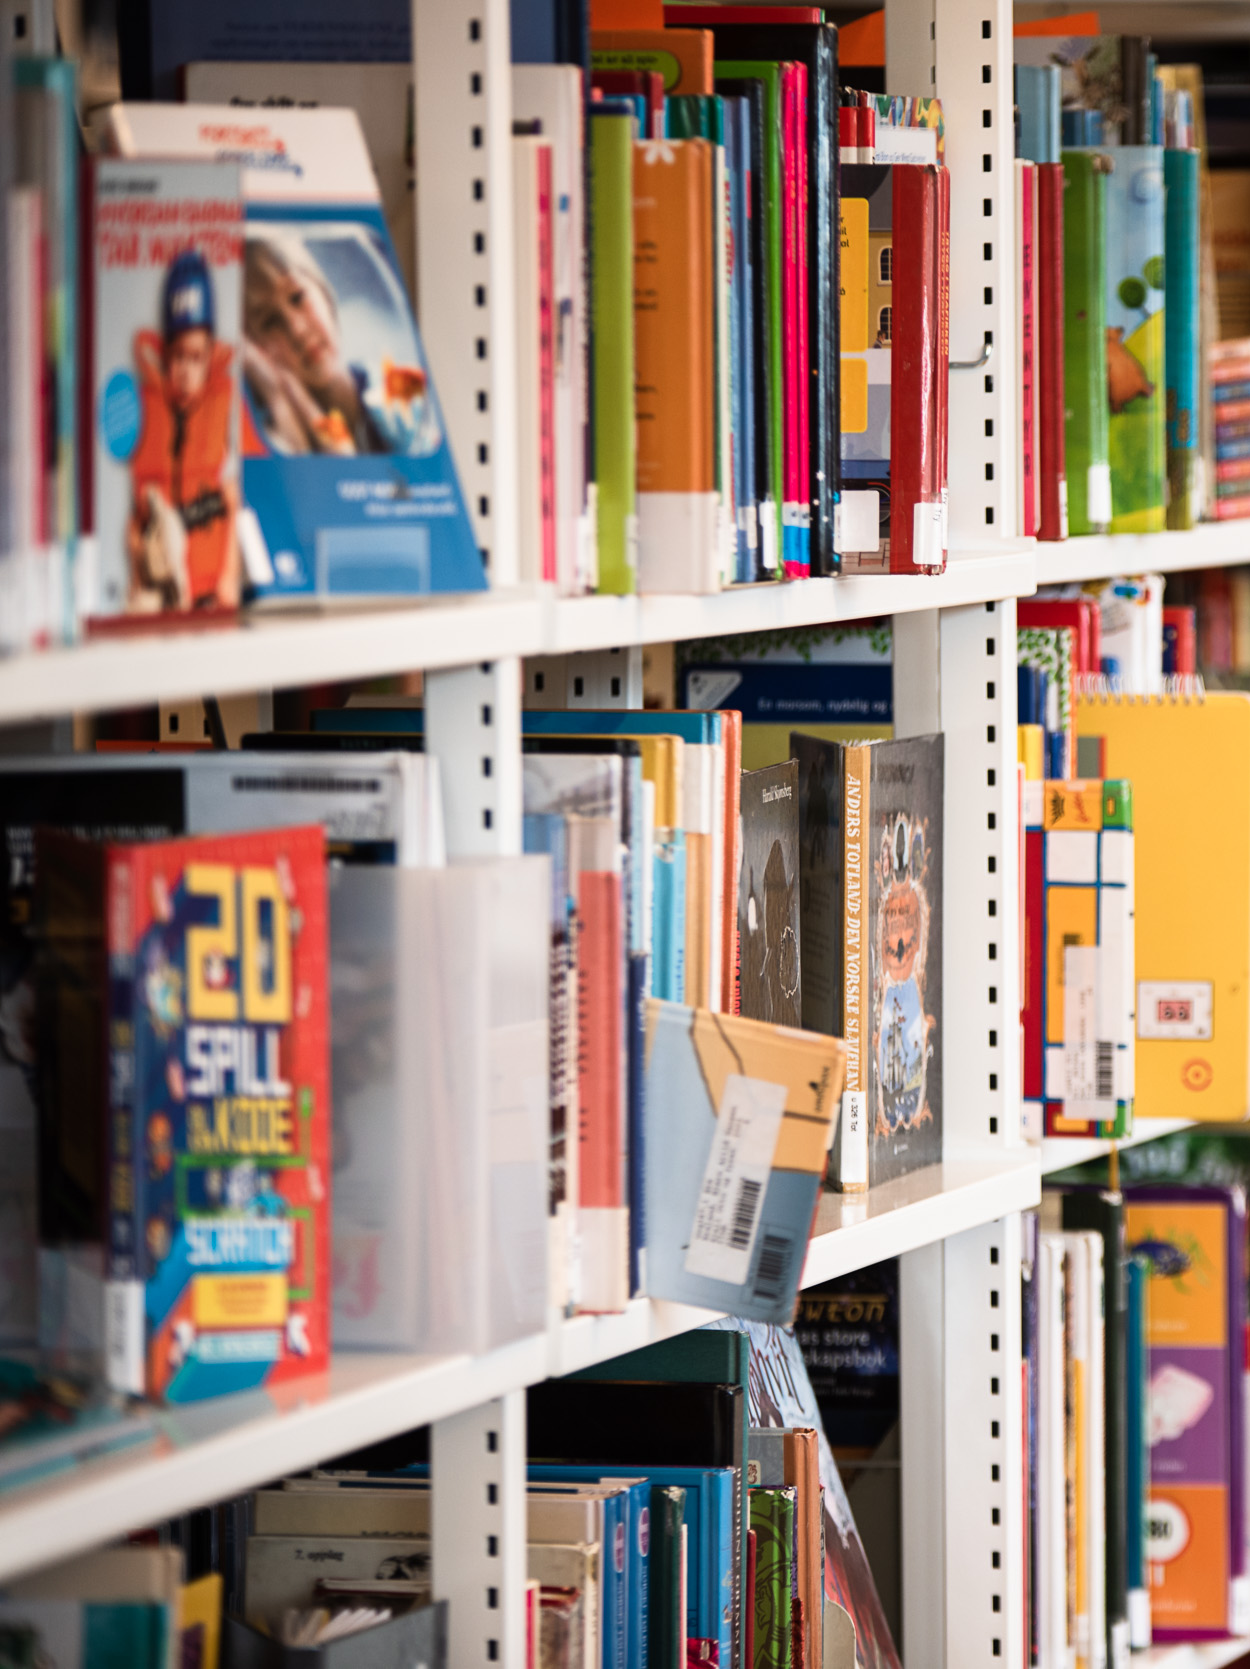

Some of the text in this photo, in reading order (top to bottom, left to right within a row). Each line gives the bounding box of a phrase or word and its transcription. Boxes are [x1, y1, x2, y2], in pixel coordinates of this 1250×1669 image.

[847, 773, 862, 837] ANDERS
[186, 864, 291, 1023] 20
[847, 916, 862, 949] DEN
[846, 951, 862, 1014] NORSKE
[186, 1023, 292, 1096] SPILL
[850, 1105, 858, 1118] 326
[186, 1216, 294, 1267] SCRATCH
[824, 1330, 870, 1348] store
